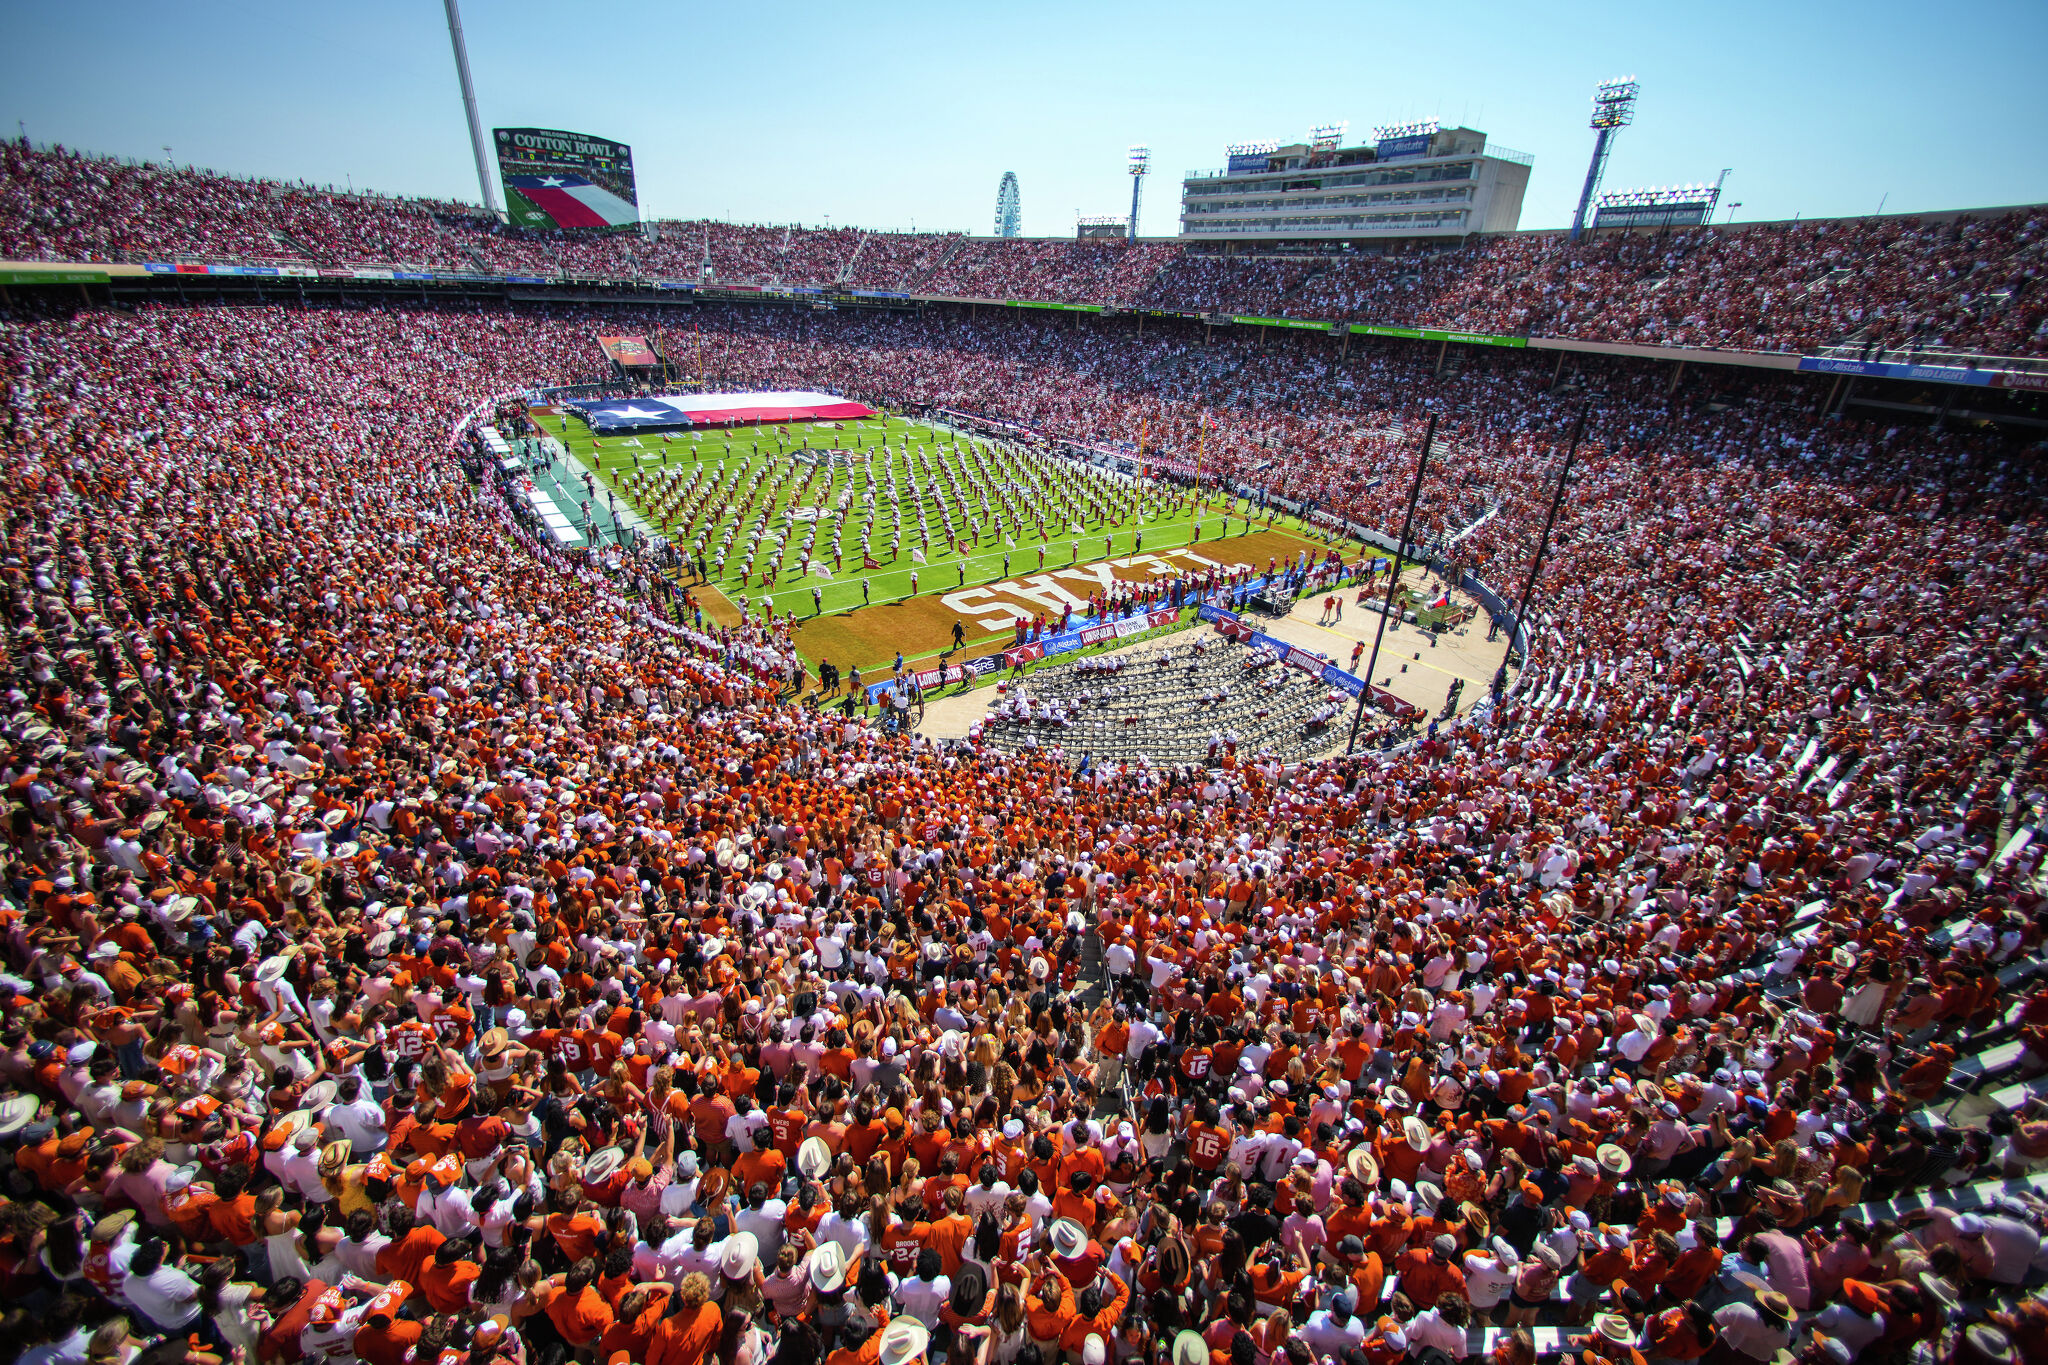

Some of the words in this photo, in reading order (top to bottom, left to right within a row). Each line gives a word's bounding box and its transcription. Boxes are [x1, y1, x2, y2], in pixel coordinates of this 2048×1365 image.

[514, 134, 572, 152] COTTON
[575, 142, 615, 158] BOWL
[1393, 141, 1424, 152] Allstate
[1241, 158, 1265, 167] Allstate
[1831, 362, 1864, 373] Allstate
[1910, 368, 1933, 378] BUD
[1933, 370, 1966, 380] LIGHT
[940, 548, 1251, 631] TEXAS
[1056, 638, 1078, 649] Allstate
[1286, 649, 1324, 673] LONGHORNS
[917, 667, 962, 688] LONGRNS
[1335, 677, 1361, 693] Allstate
[867, 870, 882, 882] 12
[975, 941, 987, 952] 10
[1306, 1014, 1317, 1024] 3
[397, 1037, 423, 1056] 12
[592, 1042, 603, 1061] 1
[1189, 1060, 1209, 1076] 16
[772, 1118, 790, 1126] EWERS
[775, 1126, 788, 1140] 3
[1199, 1131, 1220, 1141] MANNING
[1196, 1136, 1220, 1158] 16
[1244, 1152, 1256, 1166] 5
[1276, 1147, 1287, 1164] 1
[895, 1240, 919, 1248] BROOKS
[1016, 1234, 1032, 1265] 5
[894, 1246, 921, 1262] 24
